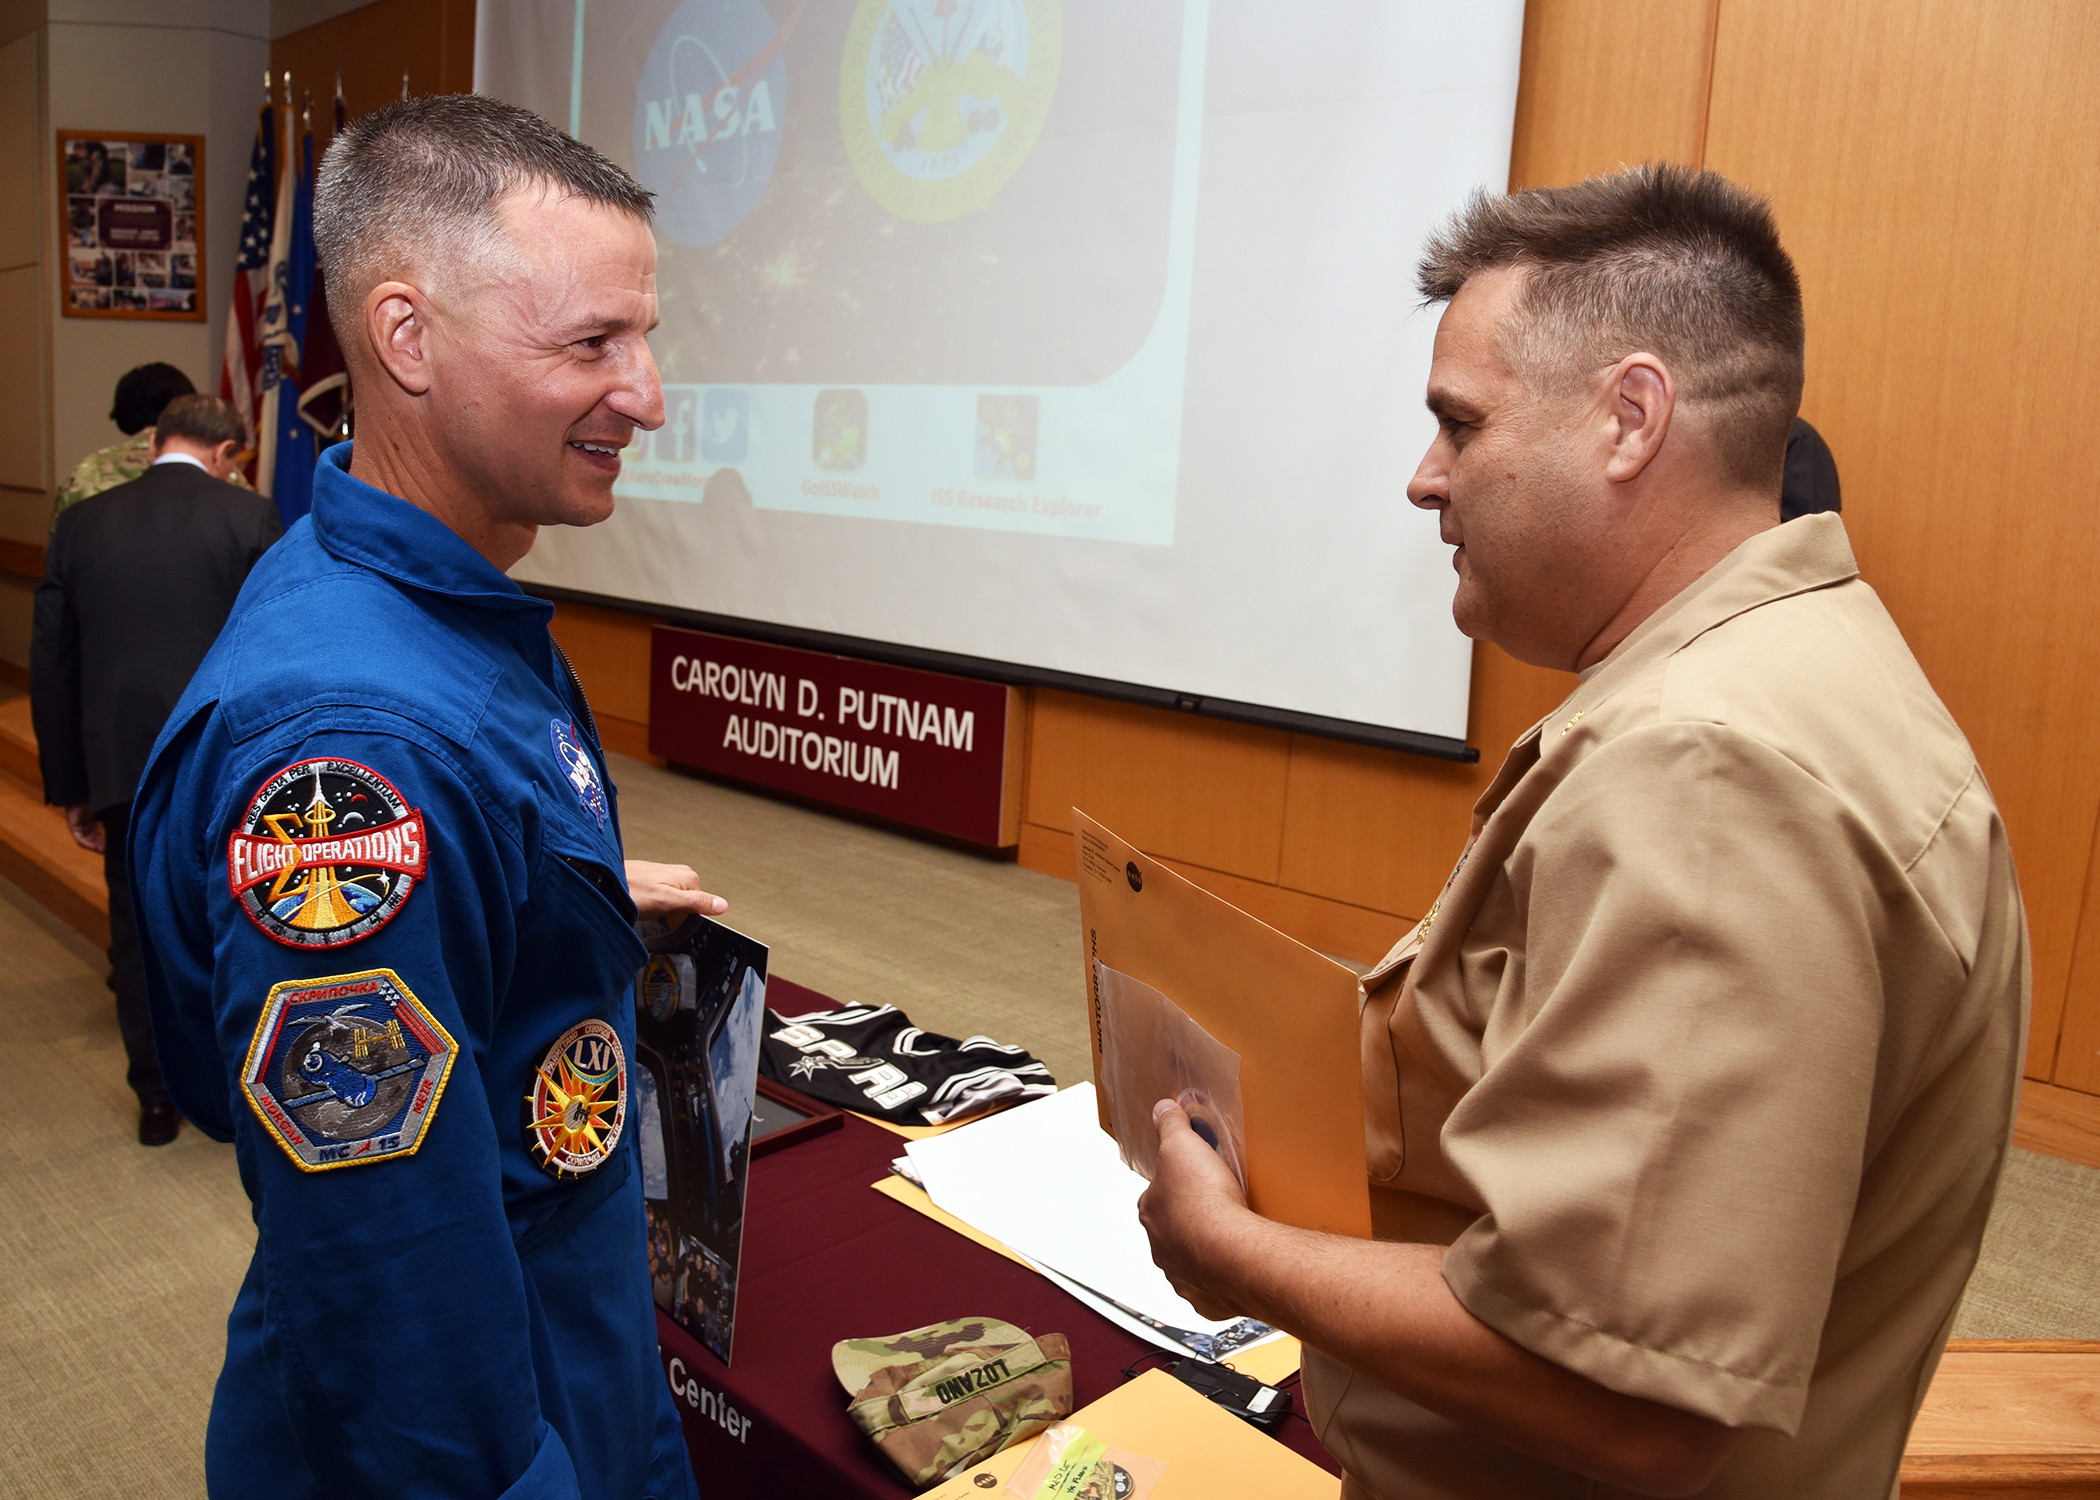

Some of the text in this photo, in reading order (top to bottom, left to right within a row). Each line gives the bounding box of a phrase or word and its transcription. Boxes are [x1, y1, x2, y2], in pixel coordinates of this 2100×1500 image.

[645, 79, 776, 152] NASA
[931, 488, 1104, 519] ISS Research Explorer
[671, 655, 975, 752] CAROLYN D. PUTNAM
[722, 714, 900, 790] AUDITORIUM
[247, 762, 401, 826] RES GESTA PER EXCELLENTIAM
[233, 821, 420, 884] FLIGHT OPERATIONS
[289, 981, 379, 1004] СКРИПОЧКА
[573, 1040, 611, 1072] LXI
[259, 1094, 304, 1145] MORGAN
[413, 1079, 434, 1115] MEIR
[378, 1136, 401, 1150] 15
[669, 1357, 752, 1445] Center
[935, 1358, 1011, 1405] LOZANO
